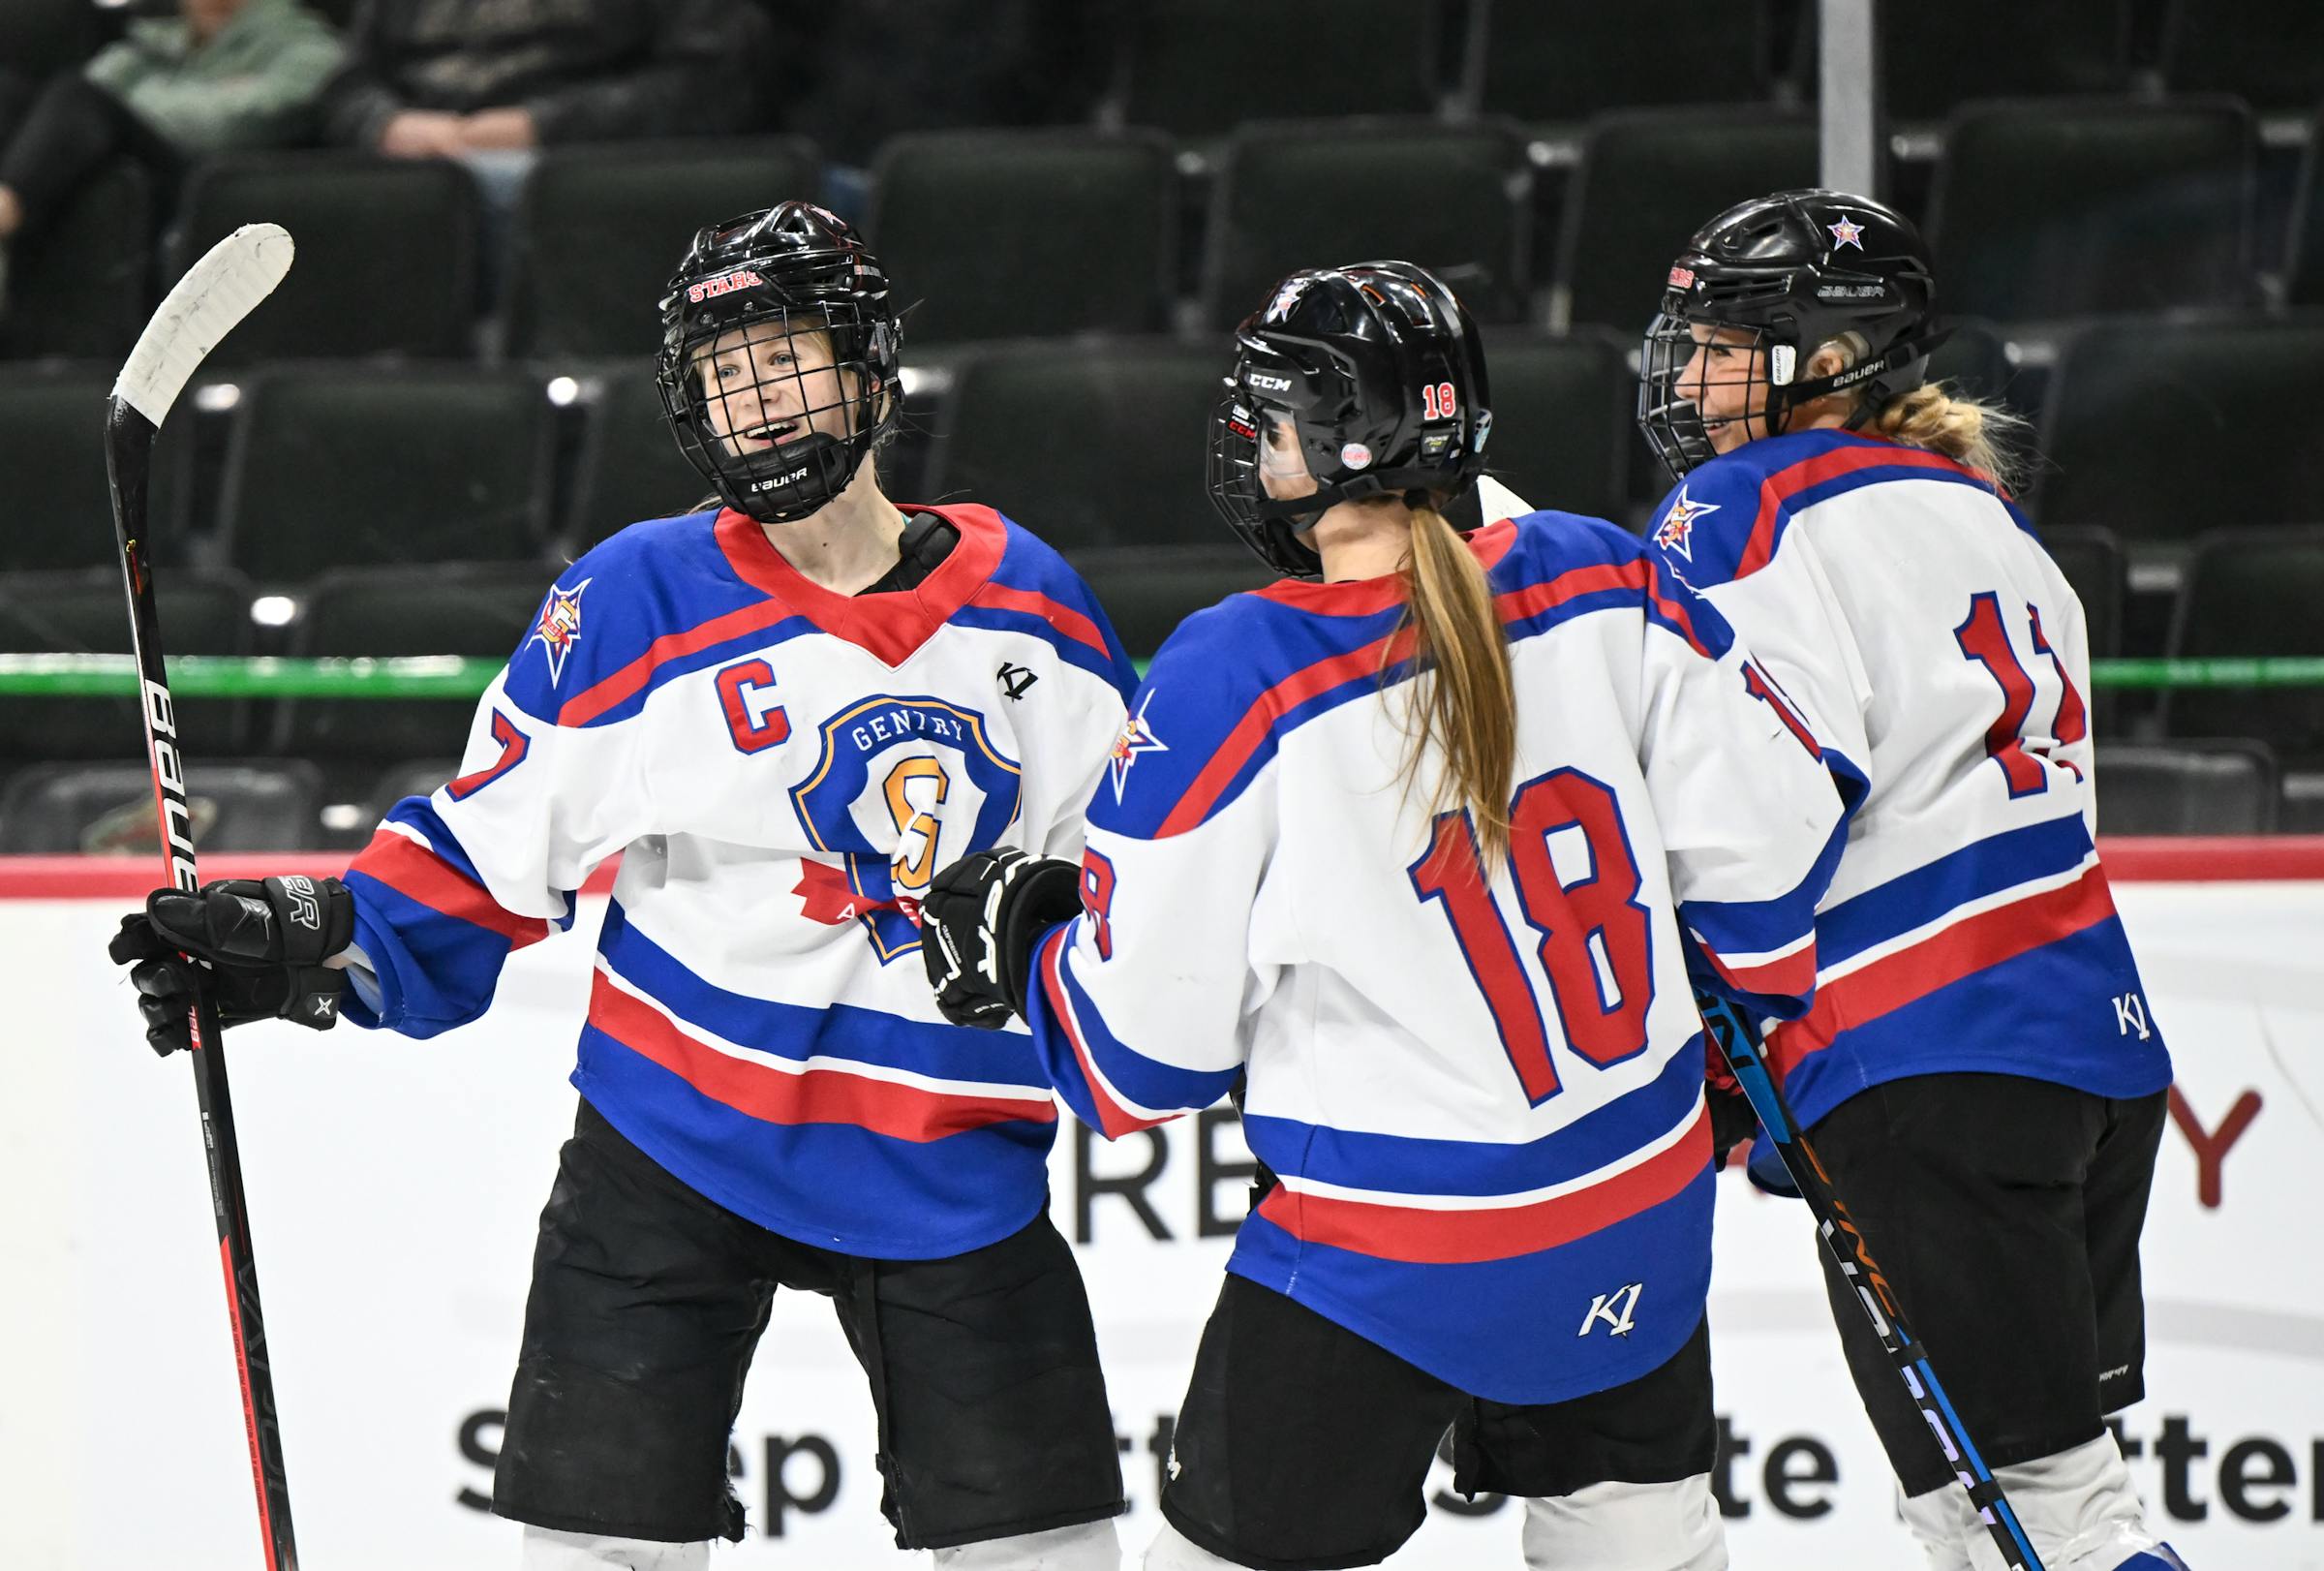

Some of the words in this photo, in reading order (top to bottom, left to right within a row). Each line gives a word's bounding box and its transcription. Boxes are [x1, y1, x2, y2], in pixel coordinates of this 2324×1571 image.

[1248, 373, 1293, 392] CCM
[1422, 383, 1456, 420] 18
[1833, 359, 1887, 387] BAUER
[714, 658, 792, 755] C
[852, 710, 963, 753] GENTRY
[1740, 654, 1823, 765] 1
[144, 679, 199, 892] BAUE
[444, 706, 532, 803] 7
[1406, 764, 1656, 1110] 18
[1577, 1280, 1644, 1340] K1
